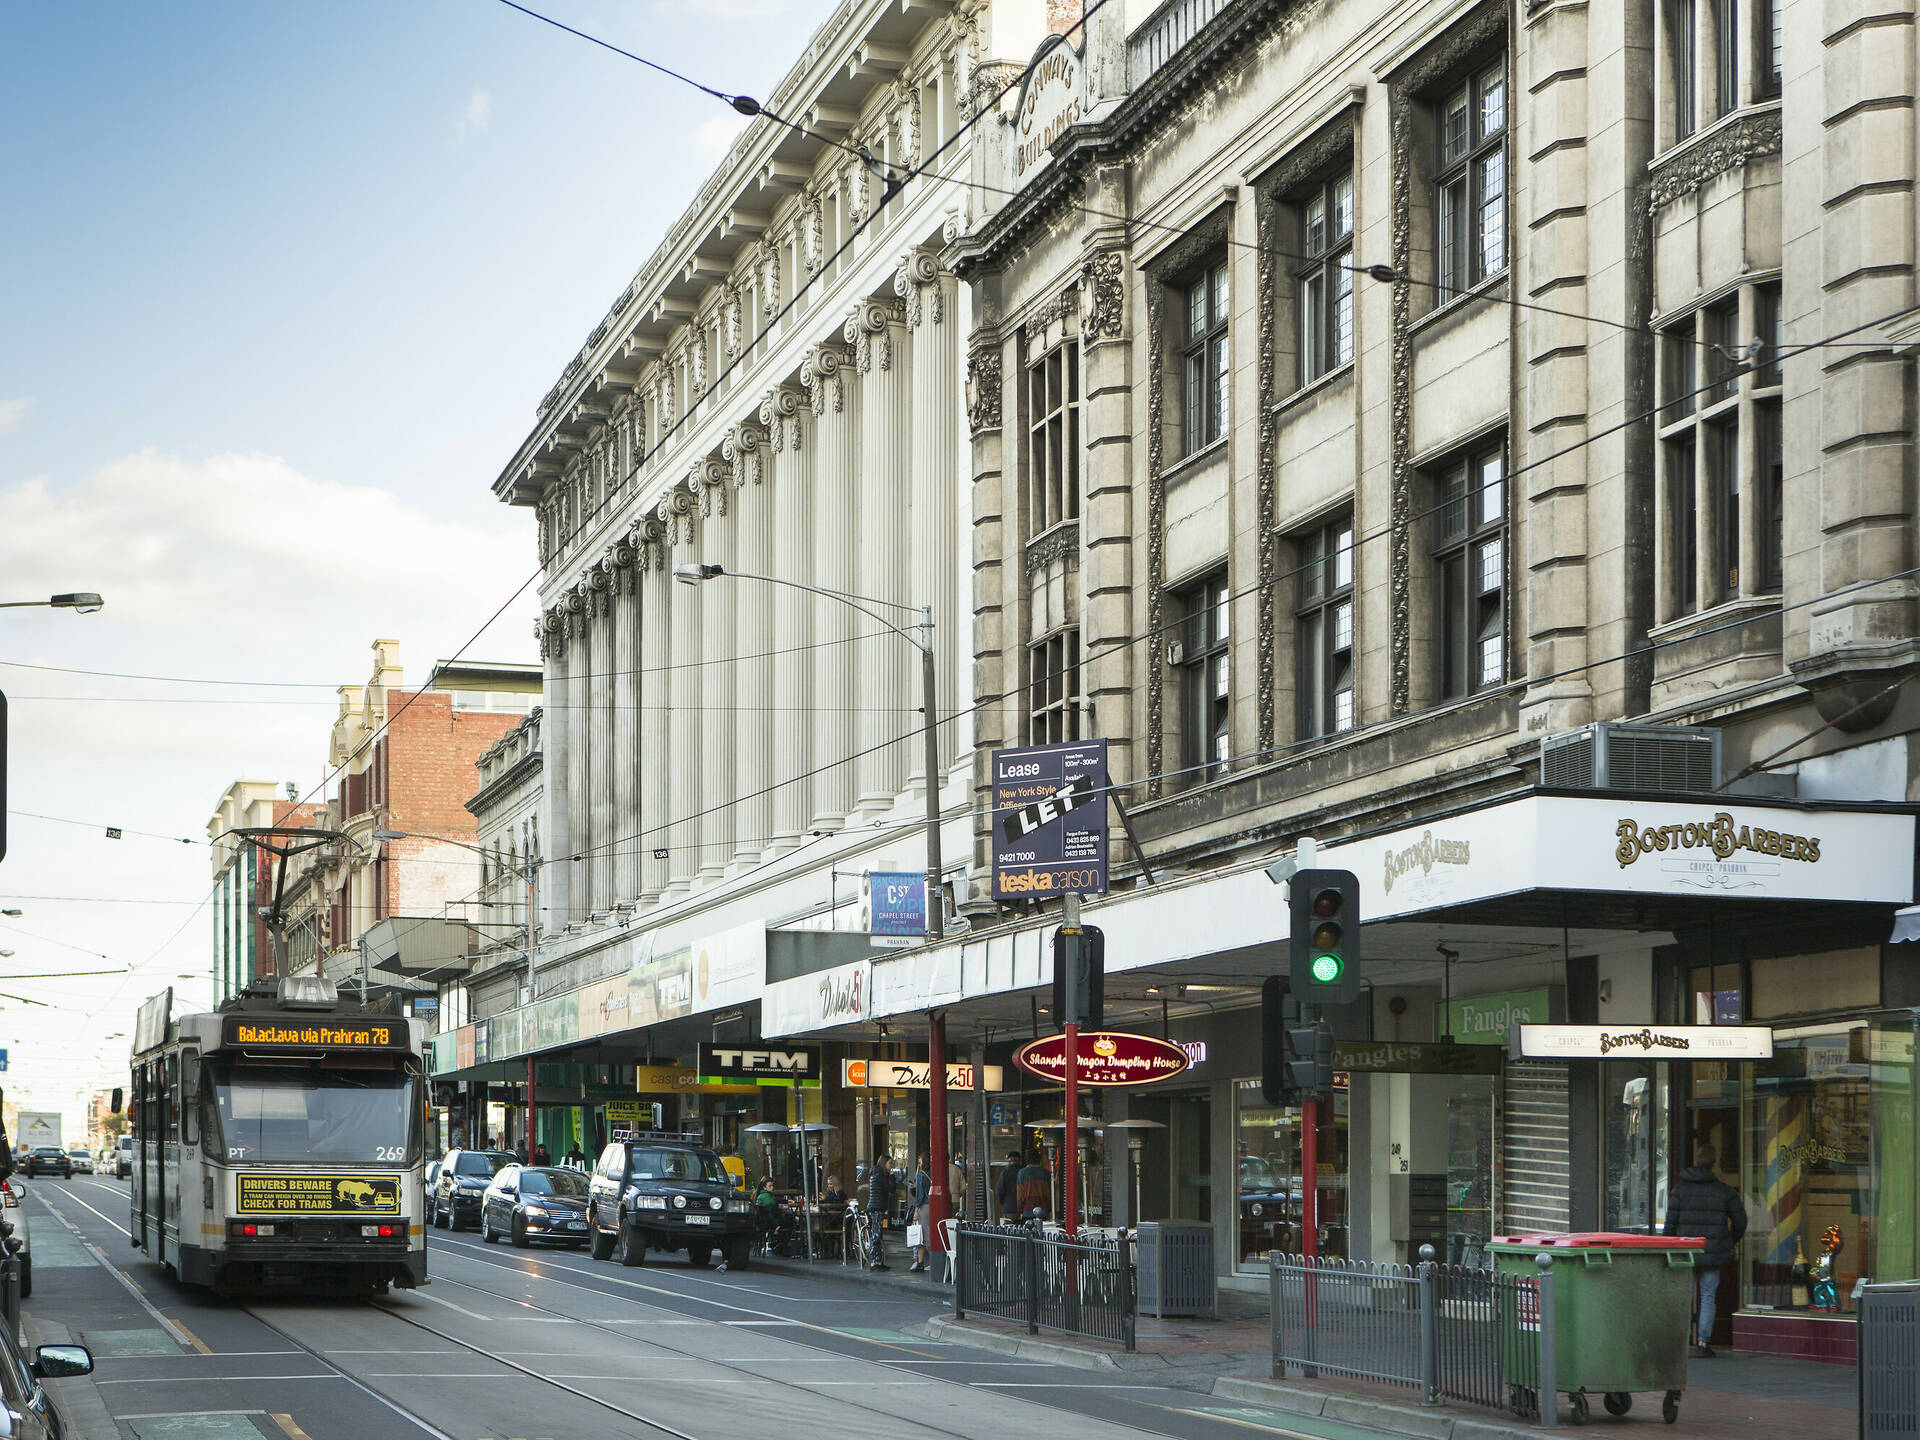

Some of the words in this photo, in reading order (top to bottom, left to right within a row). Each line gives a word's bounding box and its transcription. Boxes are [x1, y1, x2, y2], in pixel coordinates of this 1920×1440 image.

[1021, 53, 1074, 135] CONWAYS
[1018, 96, 1080, 176] BUILDINGS
[999, 762, 1040, 778] Lease
[999, 788, 1016, 799] New
[1017, 787, 1034, 797] York
[1036, 785, 1057, 796] Style
[1018, 783, 1075, 835] LET
[998, 868, 1100, 893] teskacarson
[899, 912, 919, 920] STREET
[1461, 1002, 1531, 1036] Fangles
[300, 1027, 319, 1043] via
[320, 1027, 369, 1044] Prahran
[371, 1028, 390, 1045] 78
[712, 1049, 809, 1069] TFM
[1029, 1053, 1067, 1067] Shangha
[1107, 1055, 1151, 1070] Dumpling
[1153, 1056, 1181, 1069] House
[607, 1102, 635, 1110] JUICE
[638, 1102, 652, 1111] BA
[228, 1147, 246, 1159] PT
[376, 1146, 405, 1161] 269
[243, 1179, 287, 1190] DRIVERS
[289, 1180, 332, 1190] BEWARE
[243, 1199, 275, 1208] CHECK
[277, 1199, 296, 1209] FOR
[298, 1199, 332, 1209] TRAMS
